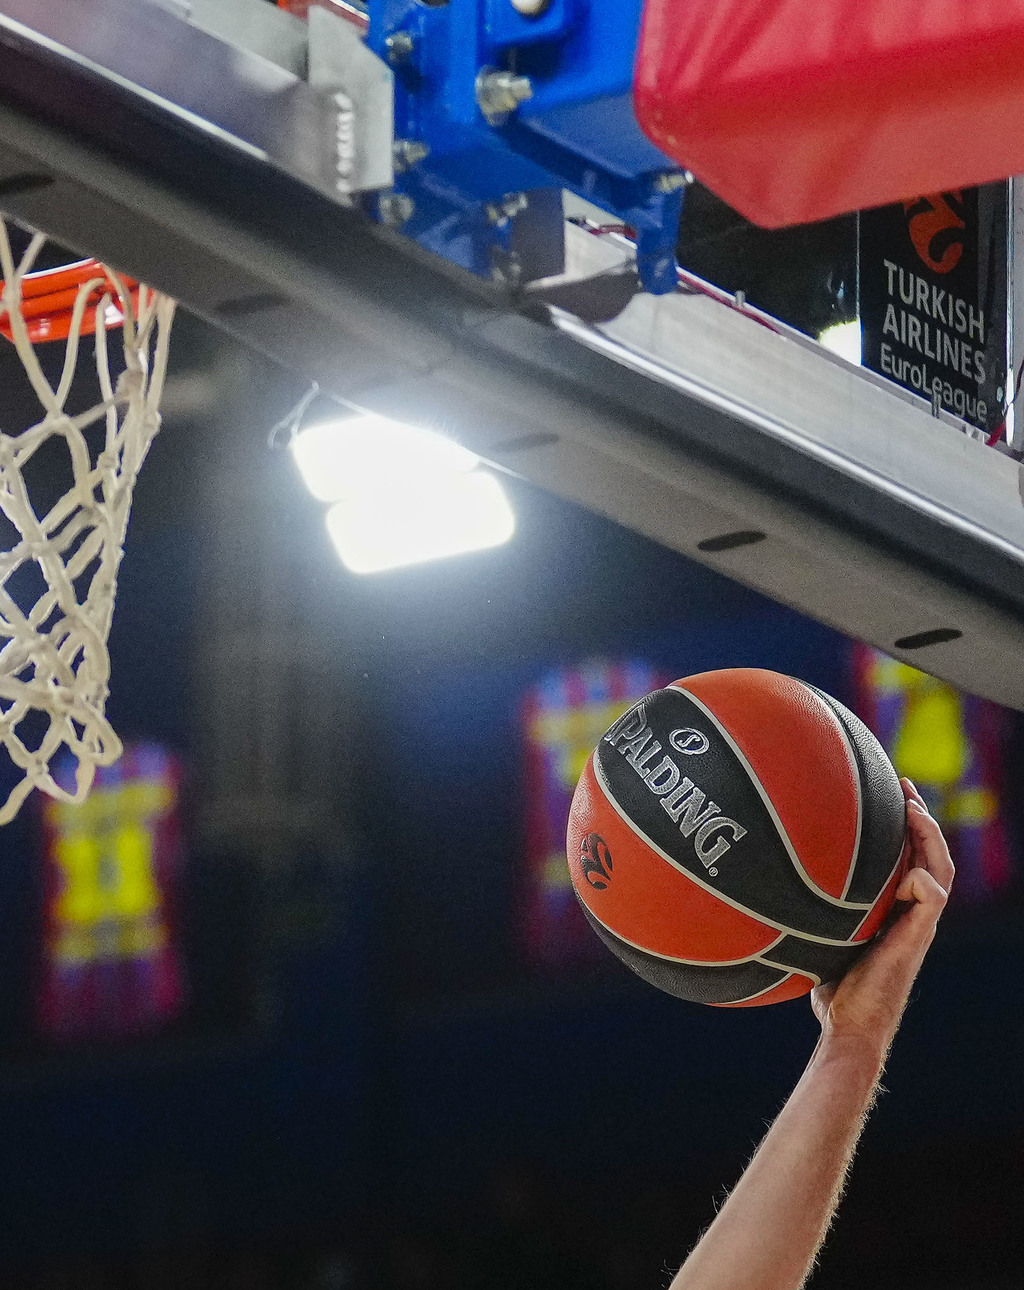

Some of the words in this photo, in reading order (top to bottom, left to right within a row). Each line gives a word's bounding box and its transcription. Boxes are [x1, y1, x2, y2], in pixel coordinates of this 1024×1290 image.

[883, 258, 985, 344] TURKISH
[880, 342, 987, 423] EuroLeague
[882, 303, 986, 385] AIRLINES
[604, 703, 748, 868] PALDING
